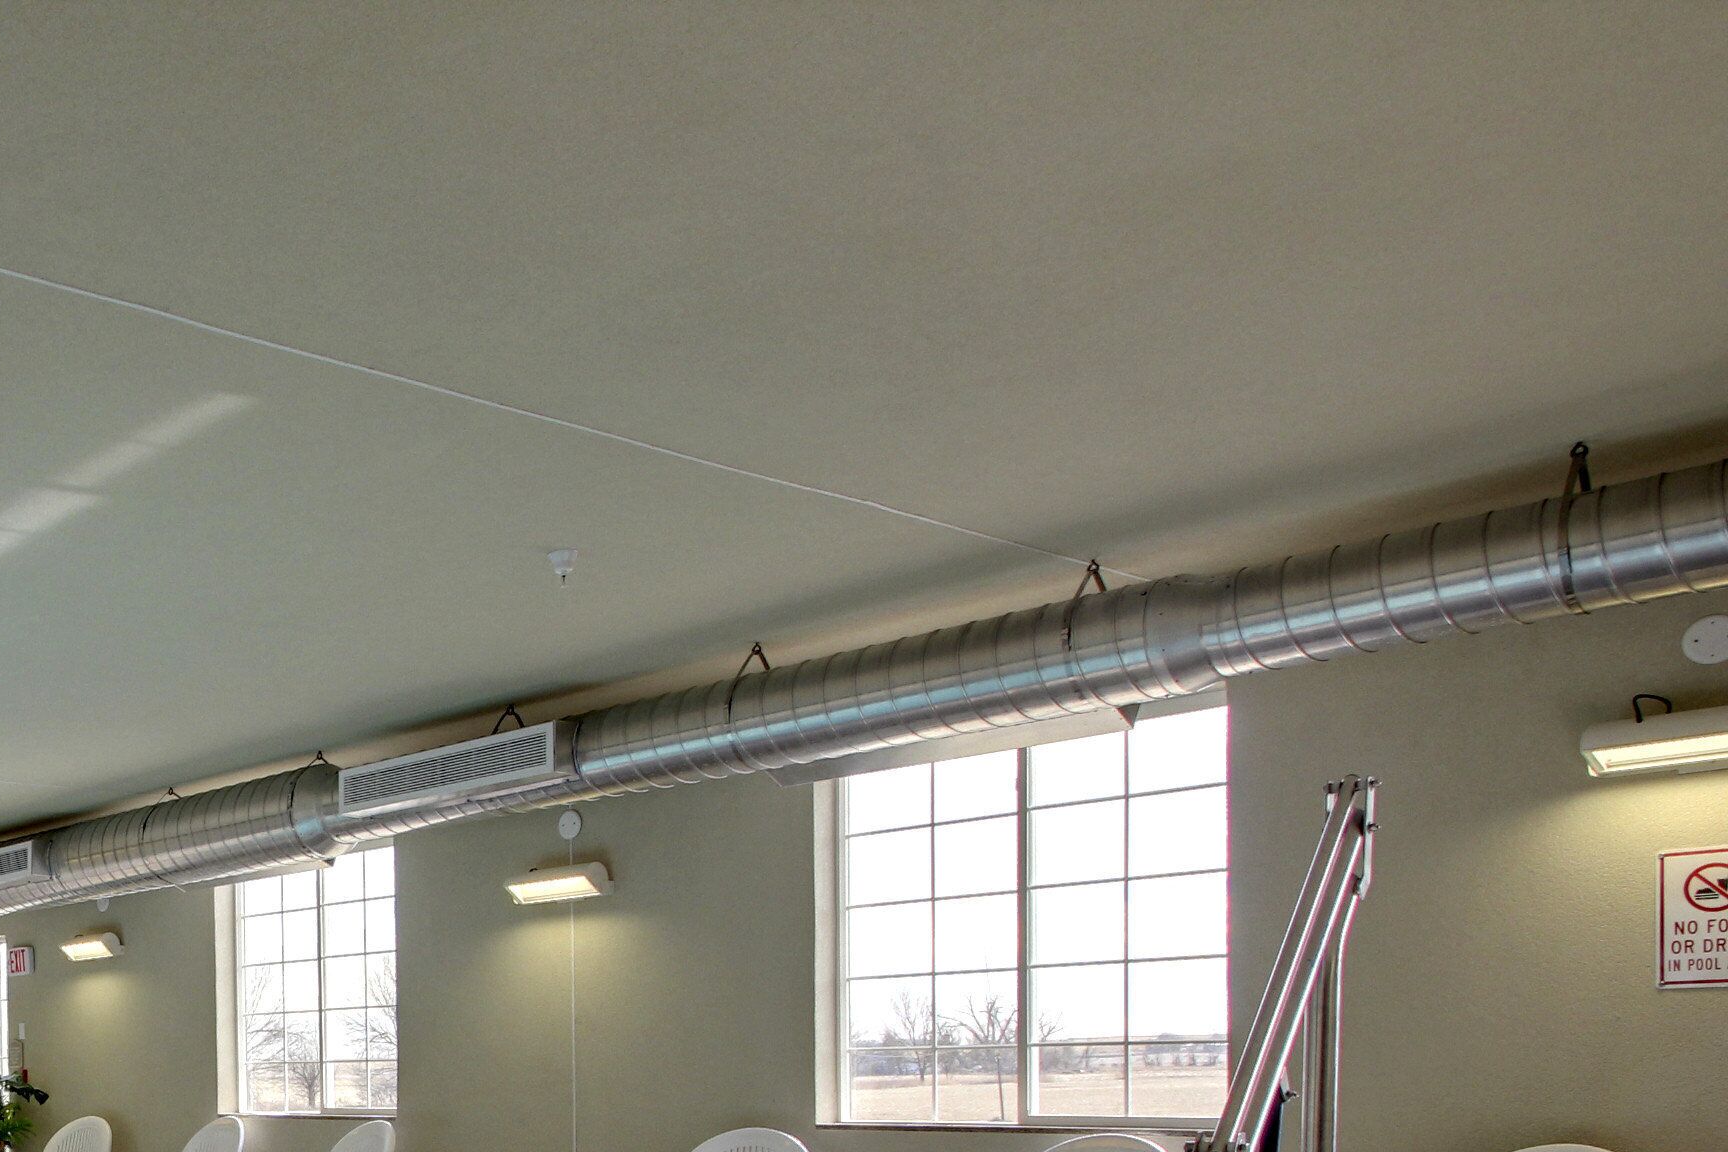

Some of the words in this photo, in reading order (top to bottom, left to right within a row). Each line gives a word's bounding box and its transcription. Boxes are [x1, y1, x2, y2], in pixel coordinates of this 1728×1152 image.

[1675, 921, 1697, 935] NO
[1671, 940, 1694, 954] OR
[10, 949, 25, 973] EXIT
[1668, 960, 1680, 971] IN
[1688, 958, 1721, 970] POOL
